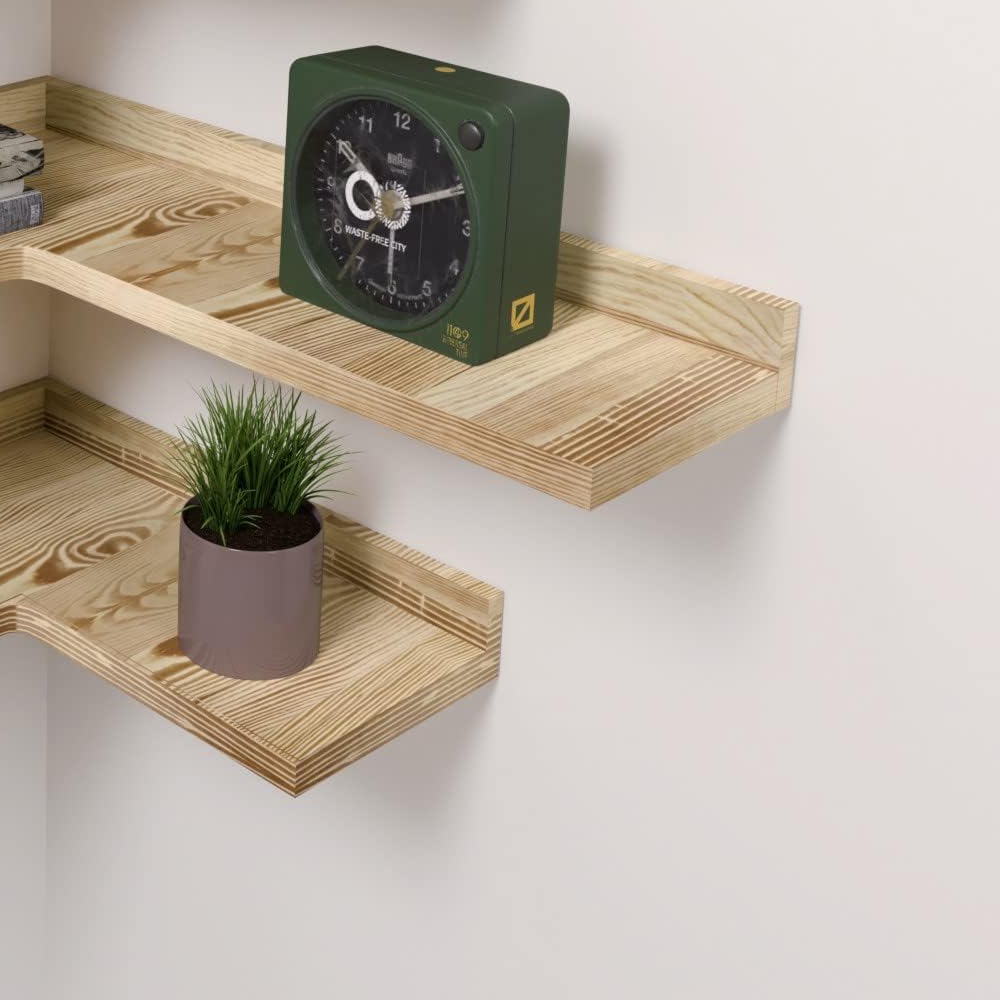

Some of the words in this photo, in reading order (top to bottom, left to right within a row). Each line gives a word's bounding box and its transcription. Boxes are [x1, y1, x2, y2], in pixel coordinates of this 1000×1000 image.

[358, 115, 373, 134] 11
[393, 111, 411, 131] 12
[433, 137, 441, 153] 1
[333, 218, 343, 234] 8
[461, 219, 471, 238] 3
[344, 224, 389, 248] WASTE-FREE
[389, 240, 408, 253] CITY
[355, 255, 365, 273] 7
[448, 258, 460, 276] 4
[387, 279, 397, 295] 6
[421, 280, 433, 297] 5
